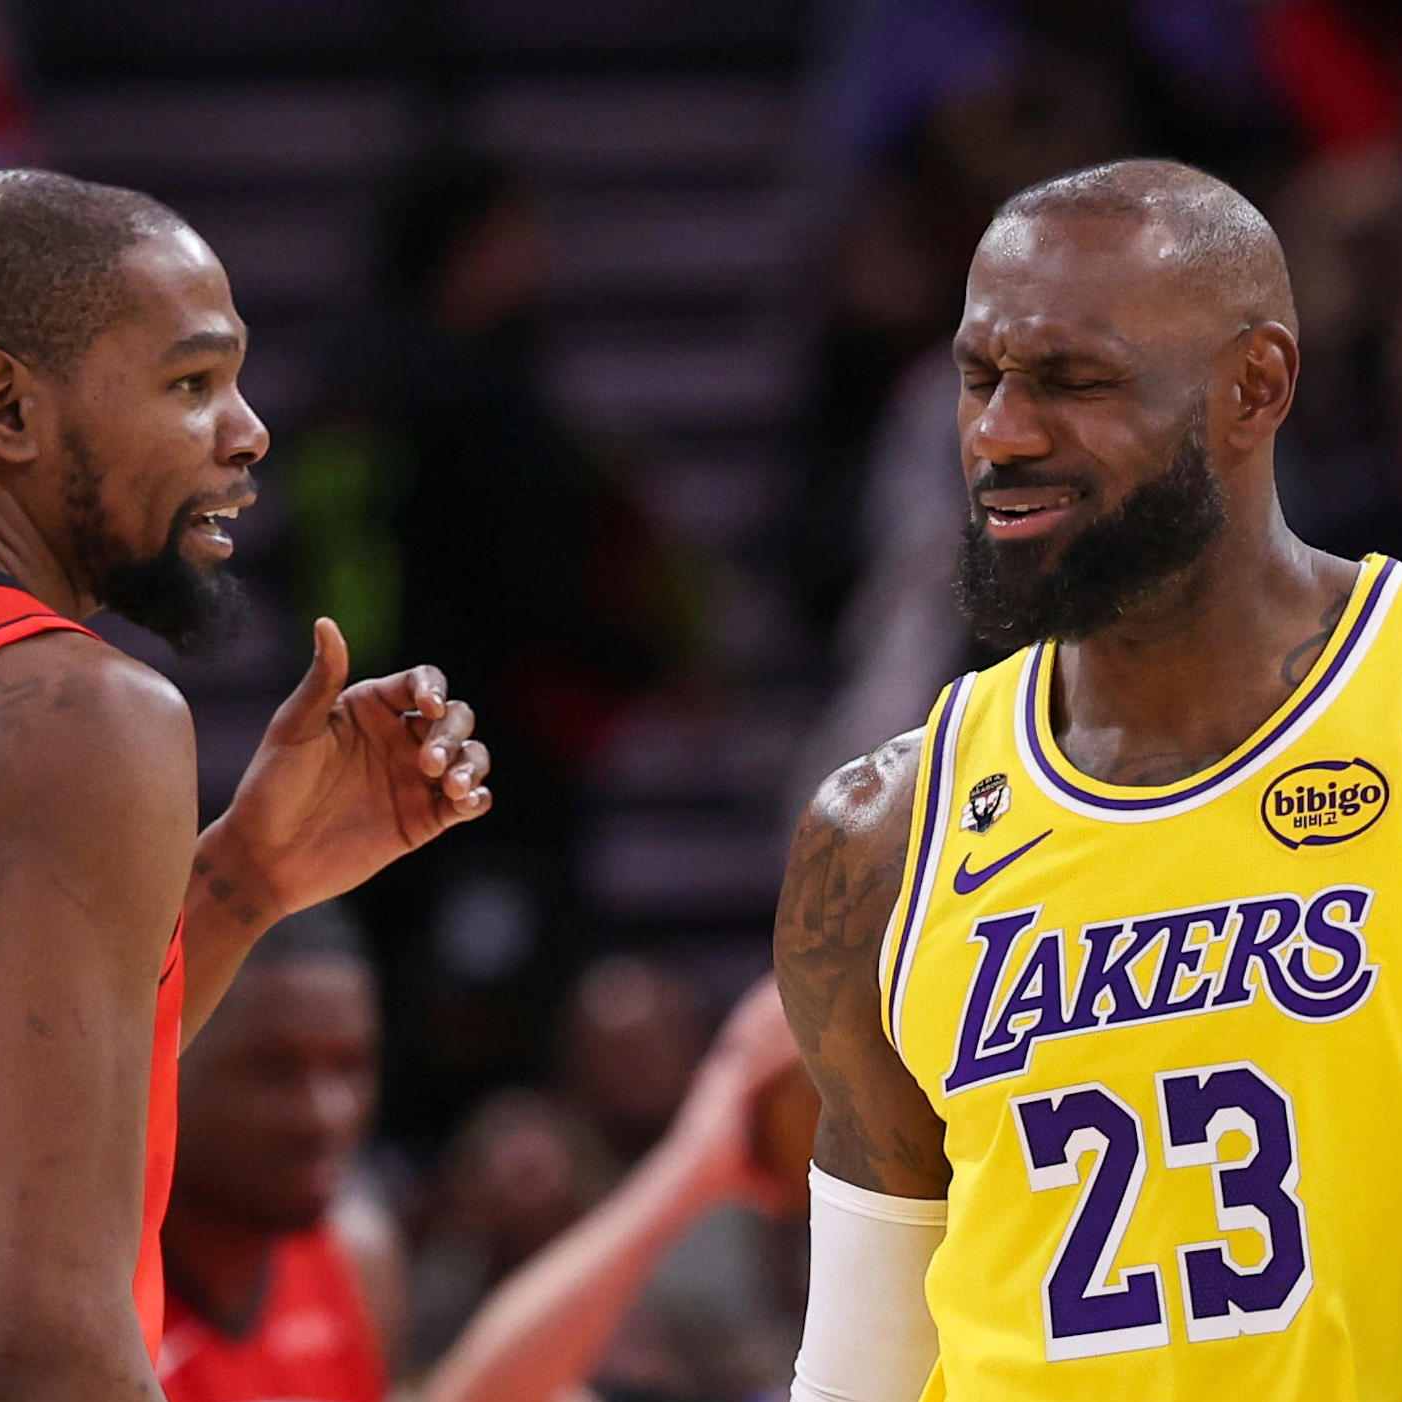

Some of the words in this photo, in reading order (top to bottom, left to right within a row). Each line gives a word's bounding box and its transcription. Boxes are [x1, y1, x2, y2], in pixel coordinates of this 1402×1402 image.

[1274, 782, 1381, 816] bibigo
[1293, 811, 1338, 829] 비비고
[941, 884, 1380, 1098] LAKERS
[1009, 1060, 1314, 1363] 23
